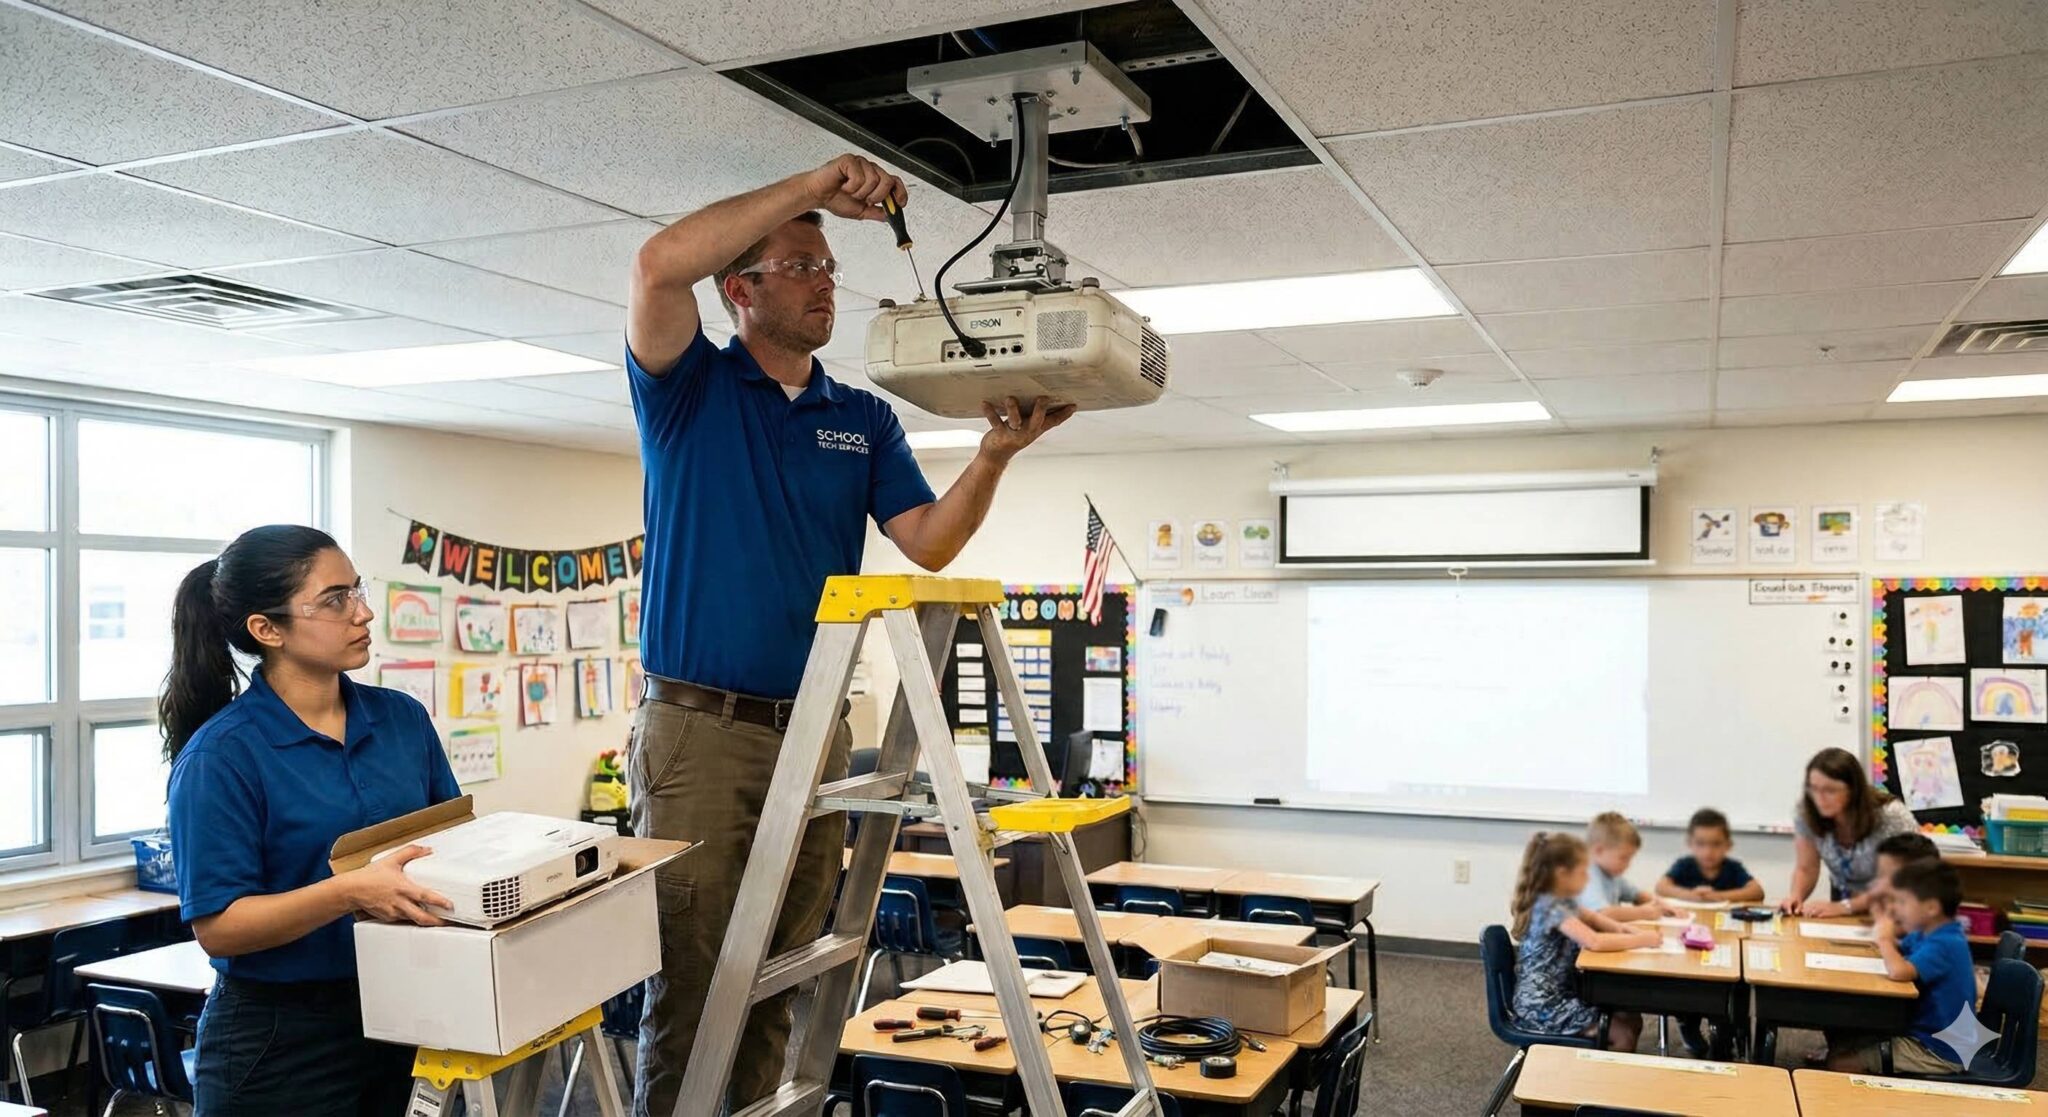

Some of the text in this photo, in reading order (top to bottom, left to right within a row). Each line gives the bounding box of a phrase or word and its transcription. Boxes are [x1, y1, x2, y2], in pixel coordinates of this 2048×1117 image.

[816, 429, 870, 446] SCHOOL
[818, 441, 837, 450] TECH
[443, 538, 625, 586] WELCOME
[997, 598, 1089, 621] ELCOME
